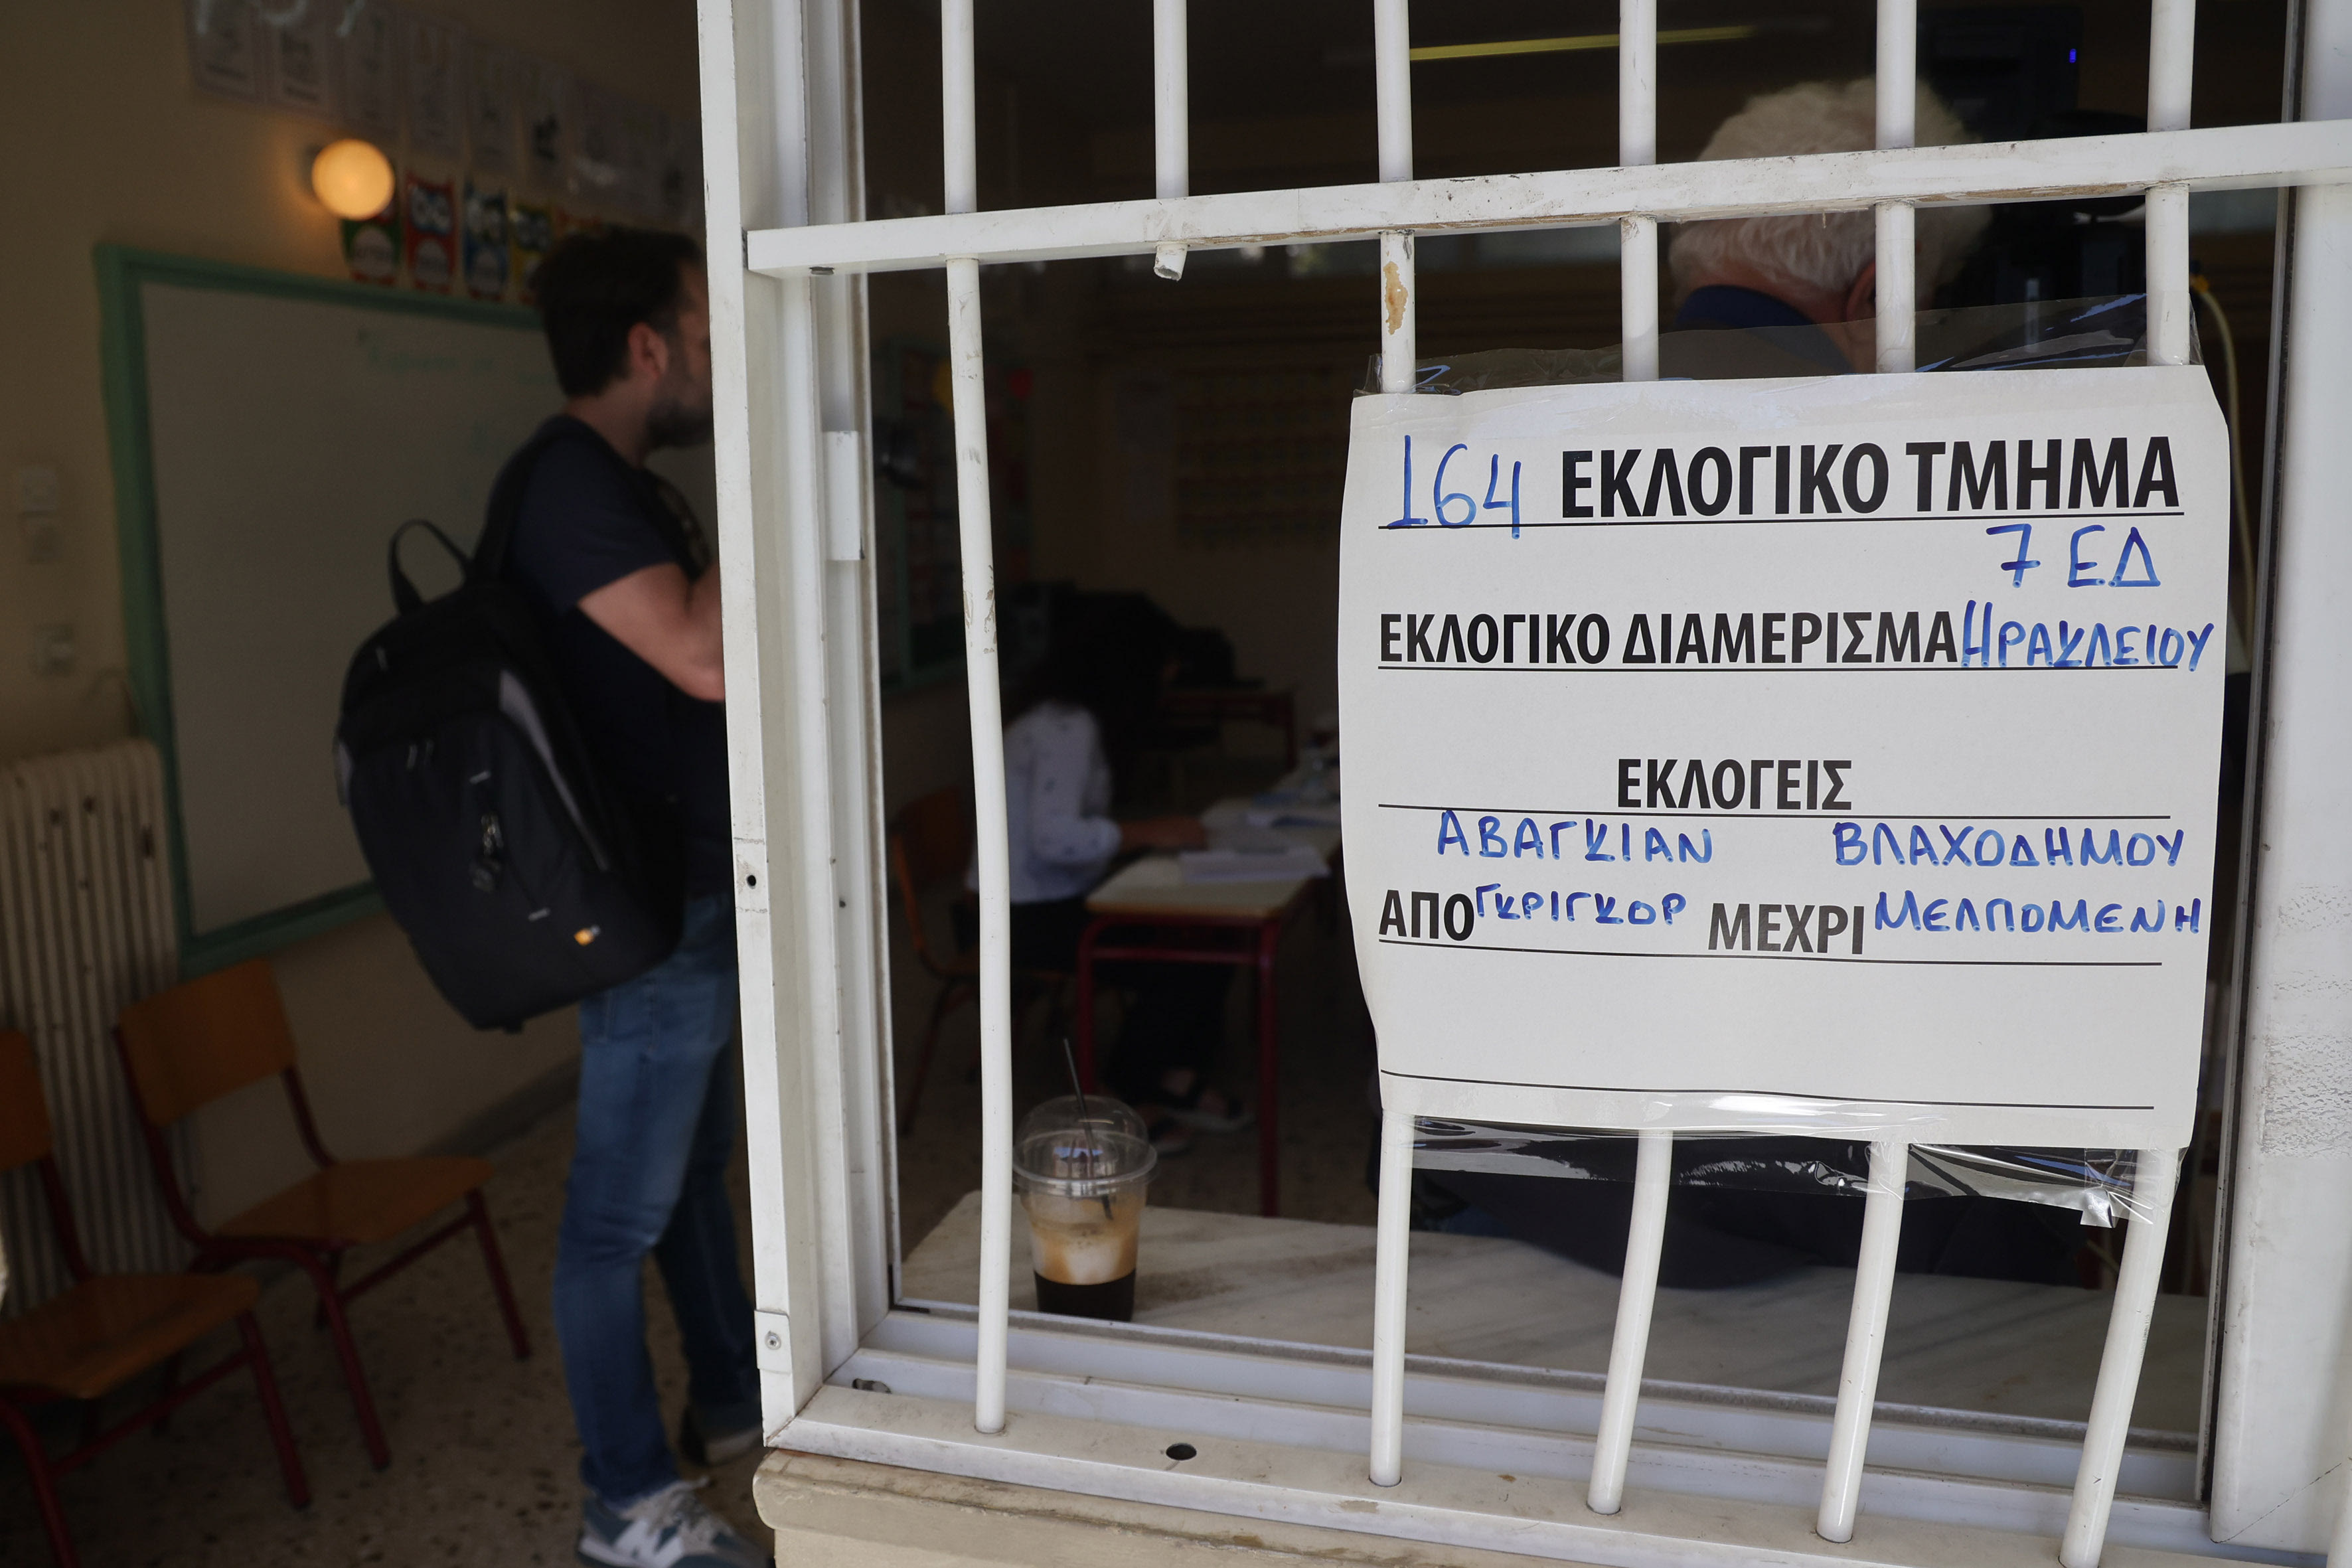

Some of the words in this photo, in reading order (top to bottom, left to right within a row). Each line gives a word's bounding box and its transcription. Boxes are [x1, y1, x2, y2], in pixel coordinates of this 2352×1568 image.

[1388, 435, 1522, 540] 164
[1562, 443, 1889, 518] ΕΚΛΟΓΙΚΟ
[1905, 436, 2179, 512] ΤΜΗΜΑ
[1987, 523, 2041, 588] 7
[1381, 613, 1610, 665] ΕΚΛΟΓΙΚΟ
[1622, 611, 1958, 664] ΔΙΑΜΕΡΙΣΜΑ
[1962, 600, 2215, 672] ΗΡΑΚΛΕΙΟΥ
[1618, 758, 1851, 811] ΕΚΛΟΓΕΙΣ
[1438, 810, 1713, 863] ΑΒΑΓΚΙΑΝ
[1833, 822, 2184, 867] ΒΛΑΧΟΔΗΜΟΥ
[1379, 890, 1474, 941] ΑΠΟ
[1708, 903, 1864, 955] ΜΕΧΡΙ
[1875, 890, 2201, 934] ΜΕΛΠΟΜΕΝΗ
